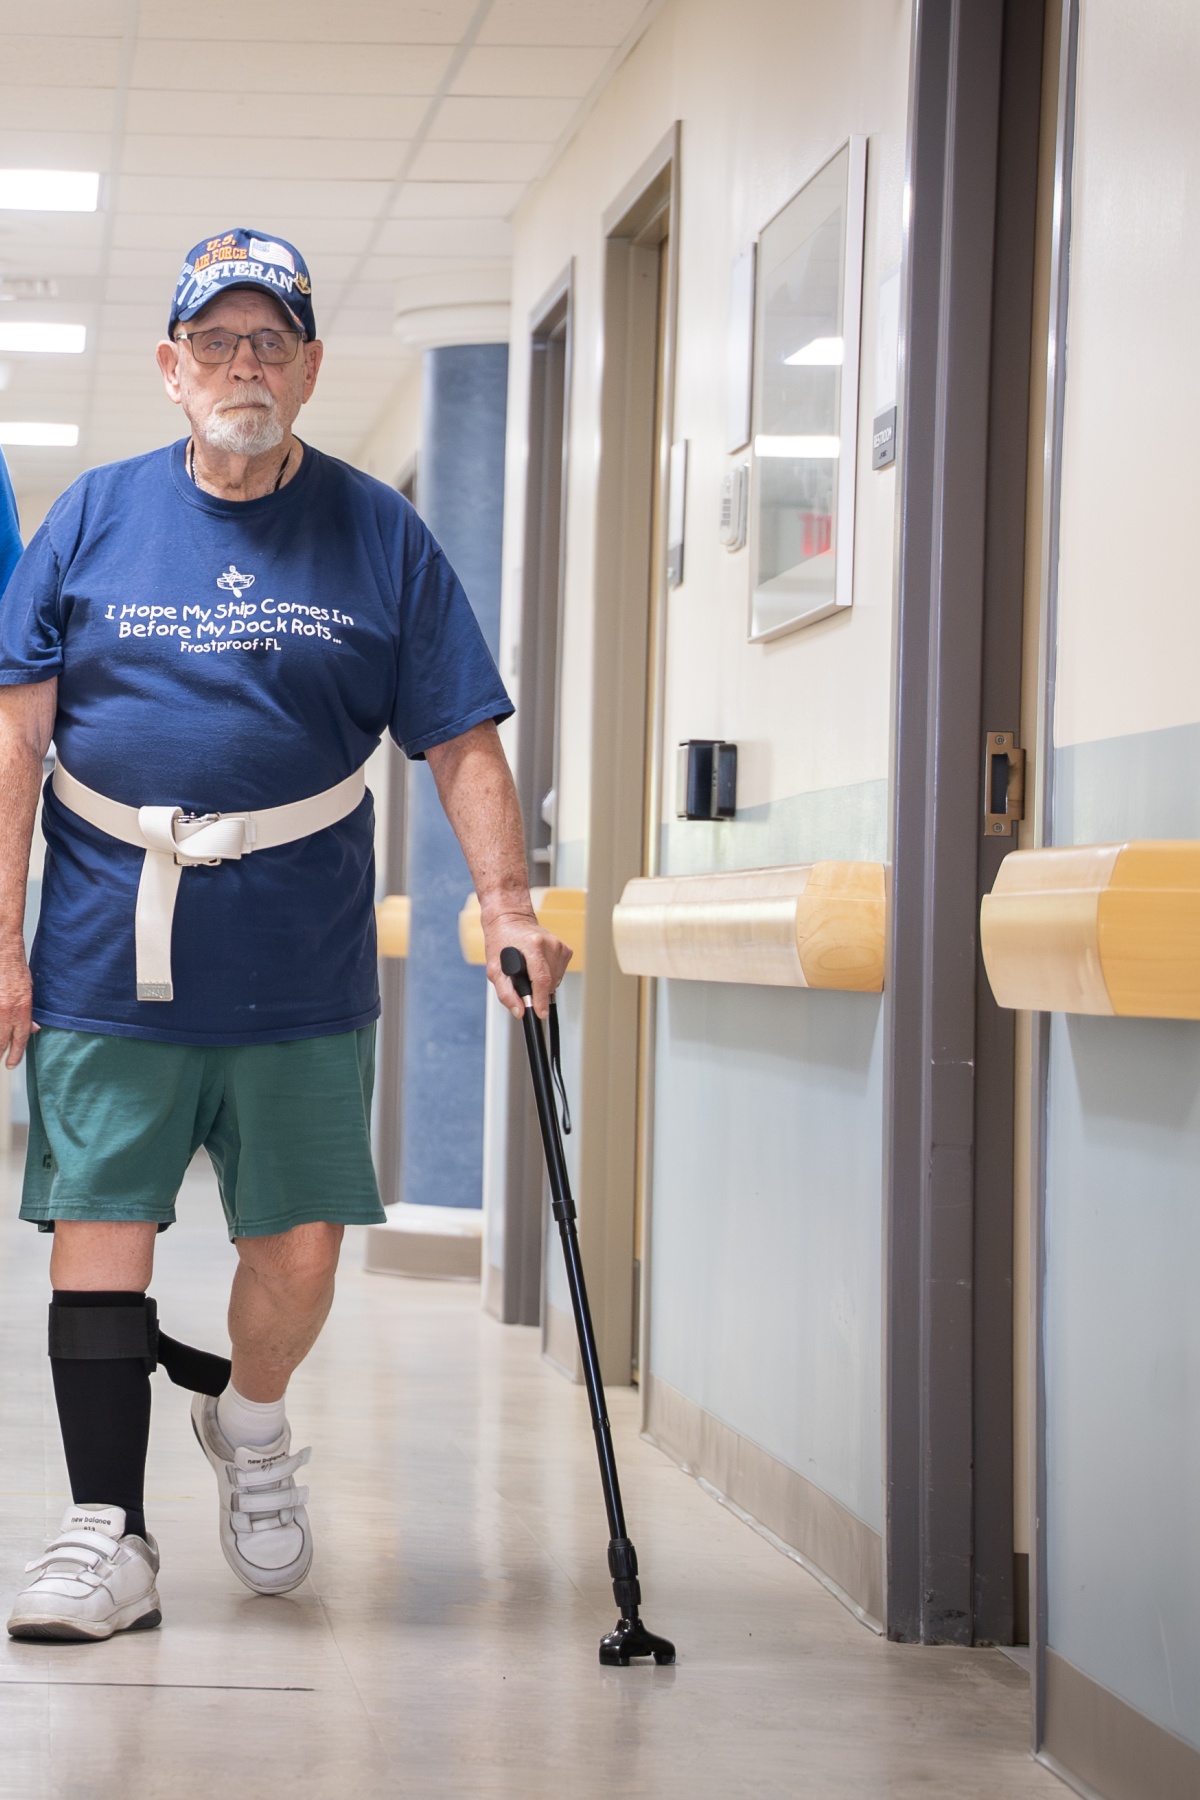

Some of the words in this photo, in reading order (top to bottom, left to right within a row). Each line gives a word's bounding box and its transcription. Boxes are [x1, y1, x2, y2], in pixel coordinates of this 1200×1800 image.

[207, 234, 237, 251] U.S.
[193, 253, 210, 273] AIR
[210, 247, 247, 264] FORCE
[193, 261, 294, 293] VETERAN
[104, 604, 116, 620] I
[119, 604, 178, 621] Hope
[182, 604, 212, 623] My
[213, 601, 257, 619] Ship
[260, 598, 330, 621] Comes
[331, 609, 355, 626] In
[119, 620, 192, 639] Before
[196, 621, 226, 638] My
[228, 616, 288, 635] Dock
[84, 1516, 111, 1525] balance
